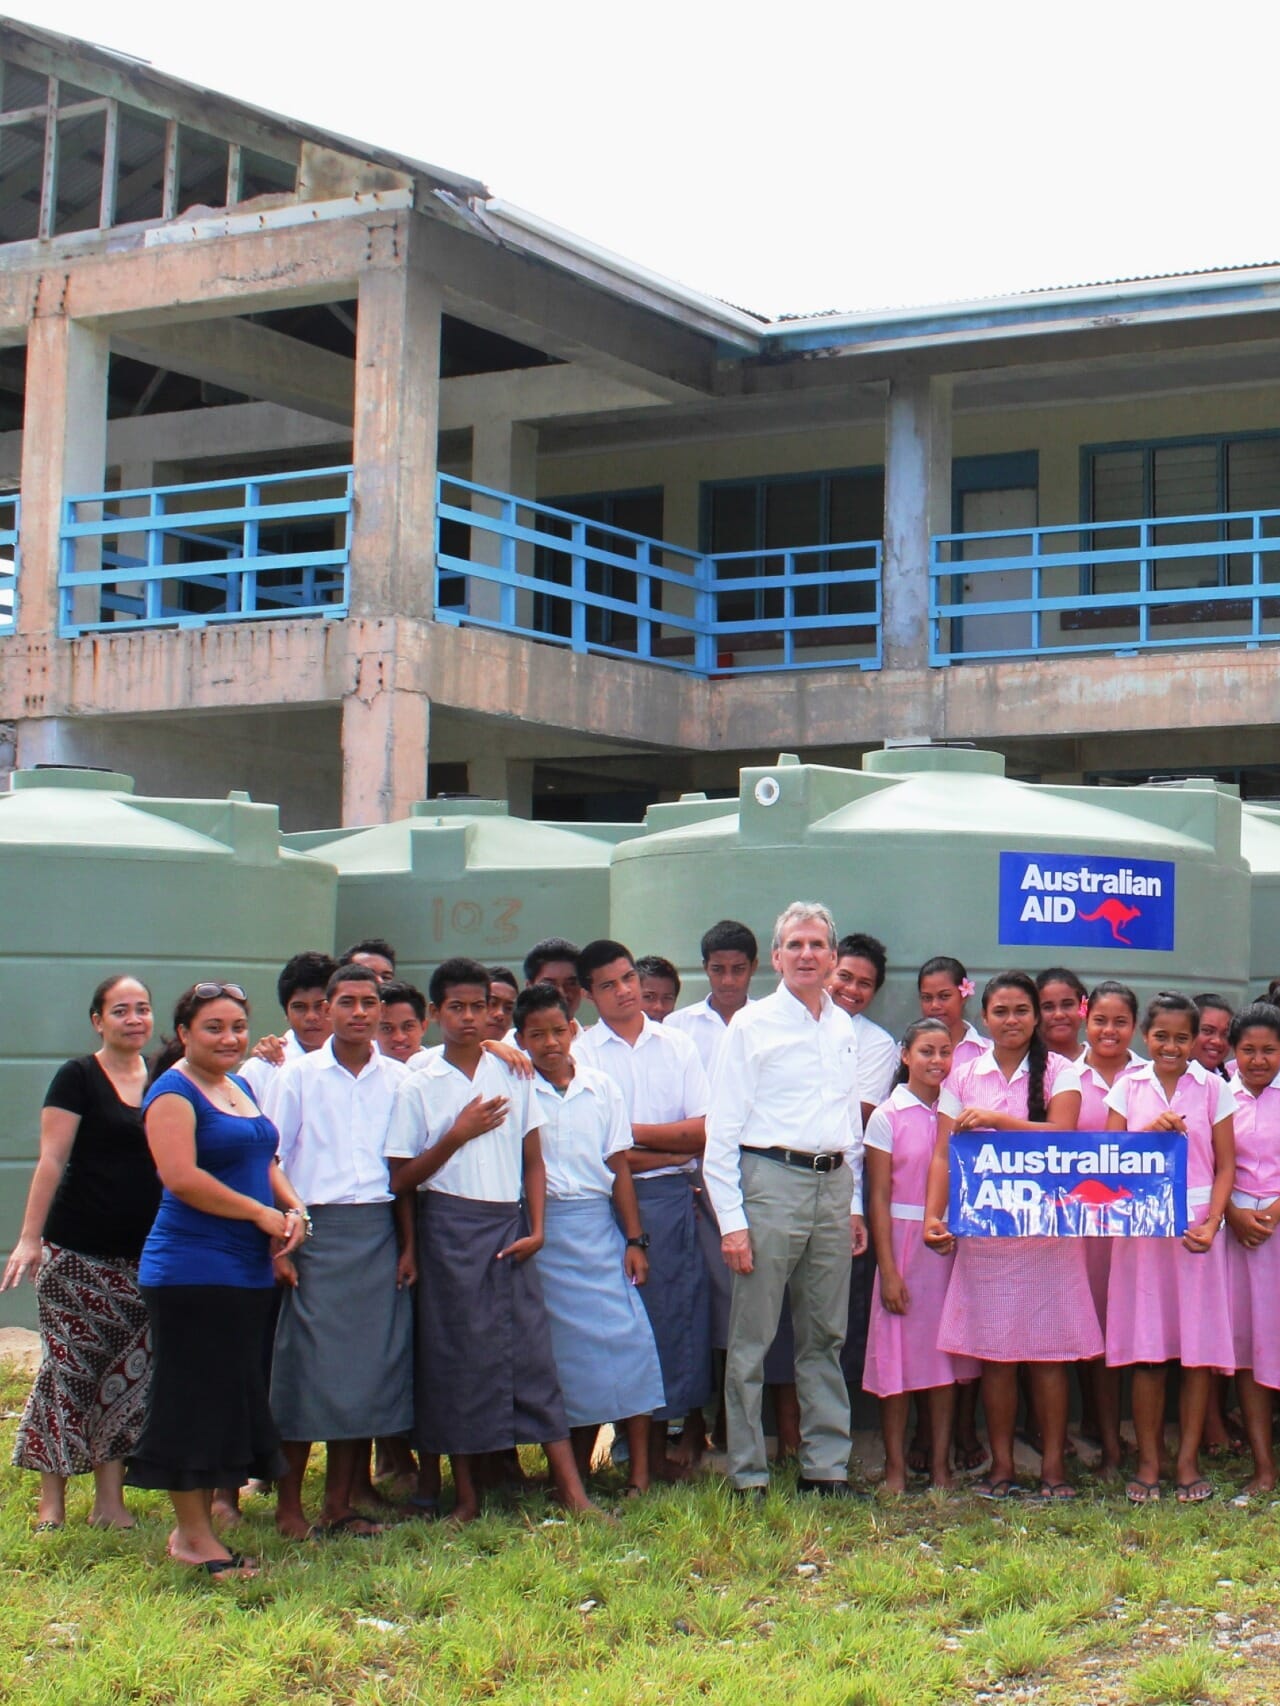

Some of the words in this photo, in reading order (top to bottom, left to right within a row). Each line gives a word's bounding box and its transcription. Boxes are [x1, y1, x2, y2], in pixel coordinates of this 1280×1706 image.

[1020, 863, 1162, 897] Australian
[432, 897, 522, 944] 103
[1020, 895, 1076, 923] AID
[973, 1144, 1166, 1174] Australian
[974, 1179, 1042, 1210] AID
